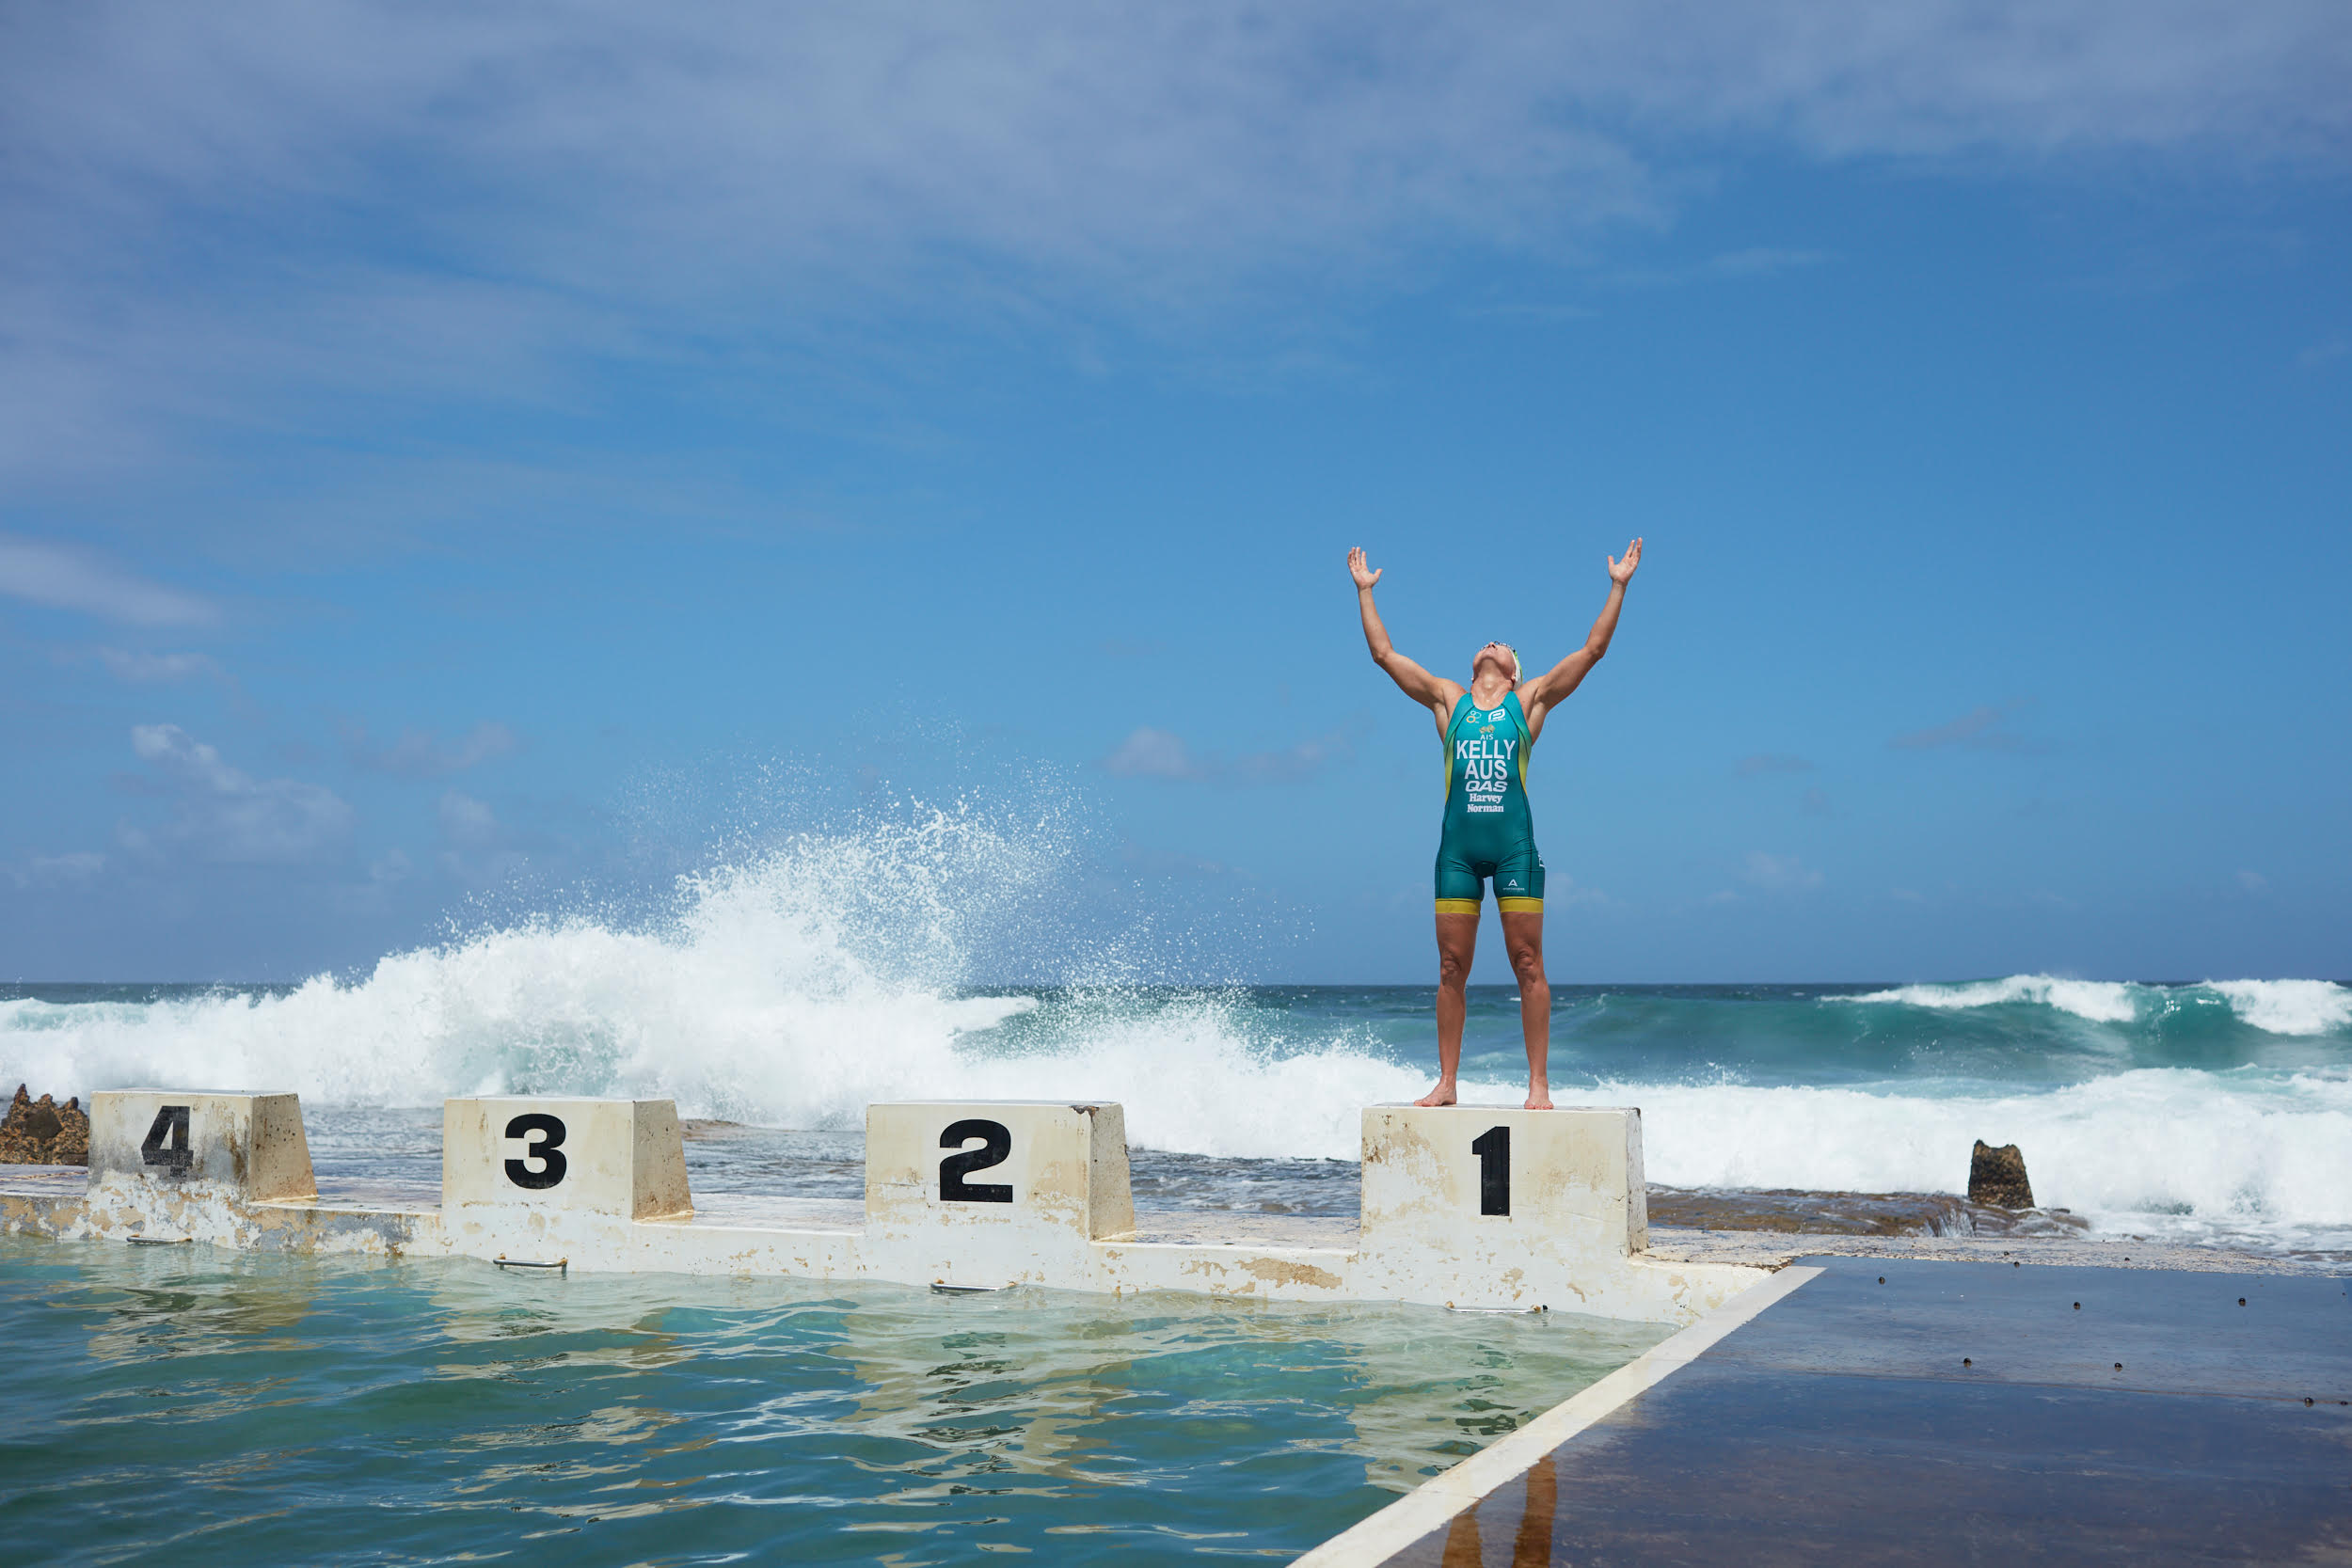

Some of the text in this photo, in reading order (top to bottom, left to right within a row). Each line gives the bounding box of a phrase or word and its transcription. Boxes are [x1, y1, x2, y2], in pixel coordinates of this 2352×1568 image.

[1456, 739, 1516, 760] KELLY
[1464, 760, 1508, 780] AUS
[1465, 781, 1508, 792] QAS
[1467, 804, 1504, 813] Norman
[1469, 793, 1503, 804] Harvey
[140, 1105, 194, 1180] 4
[504, 1113, 567, 1190] 3
[939, 1118, 1013, 1204] 2
[1471, 1125, 1511, 1217] 1
